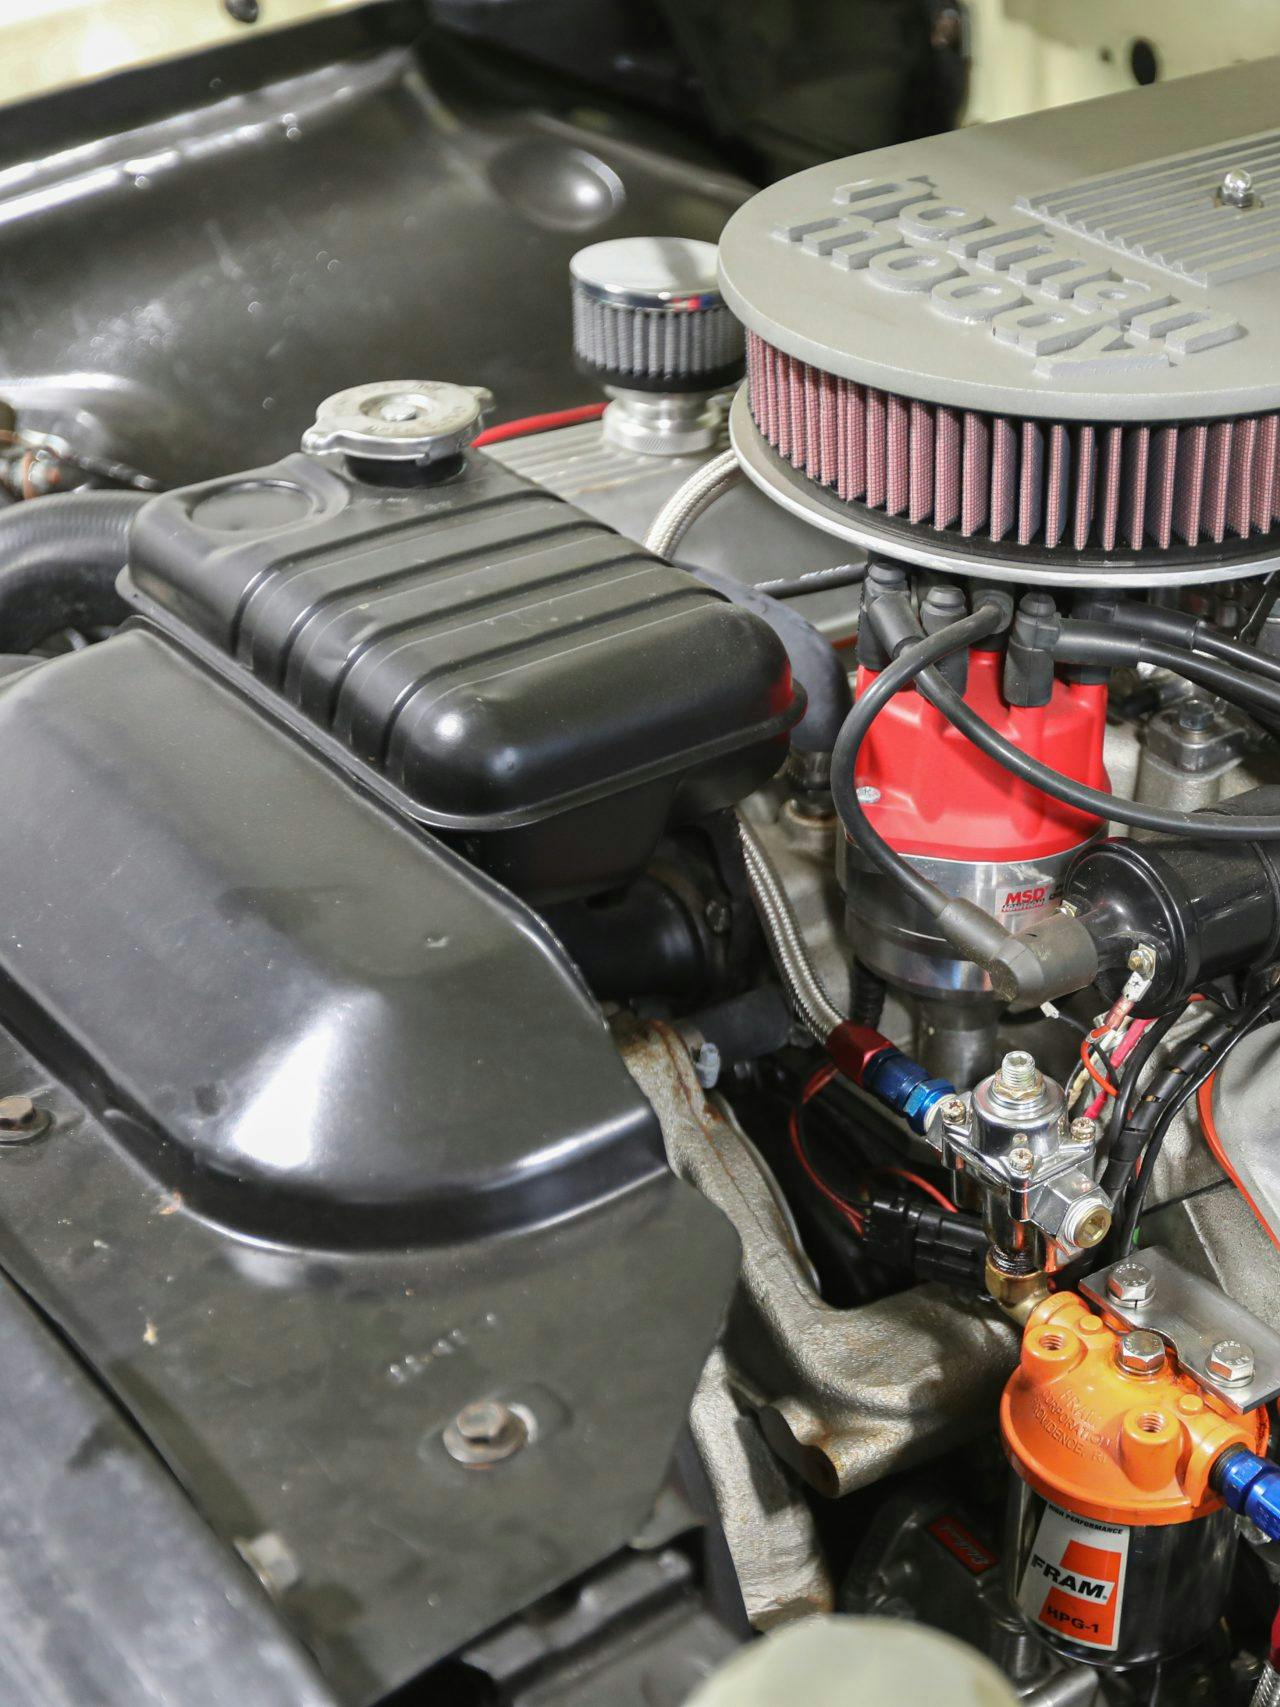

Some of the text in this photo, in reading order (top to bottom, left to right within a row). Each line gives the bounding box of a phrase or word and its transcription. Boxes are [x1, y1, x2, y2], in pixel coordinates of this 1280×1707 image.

[769, 212, 1180, 379] moody
[1004, 886, 1046, 905] MSD
[1065, 1514, 1124, 1535] PERFORMANCE
[1047, 1605, 1100, 1634] HPG-1
